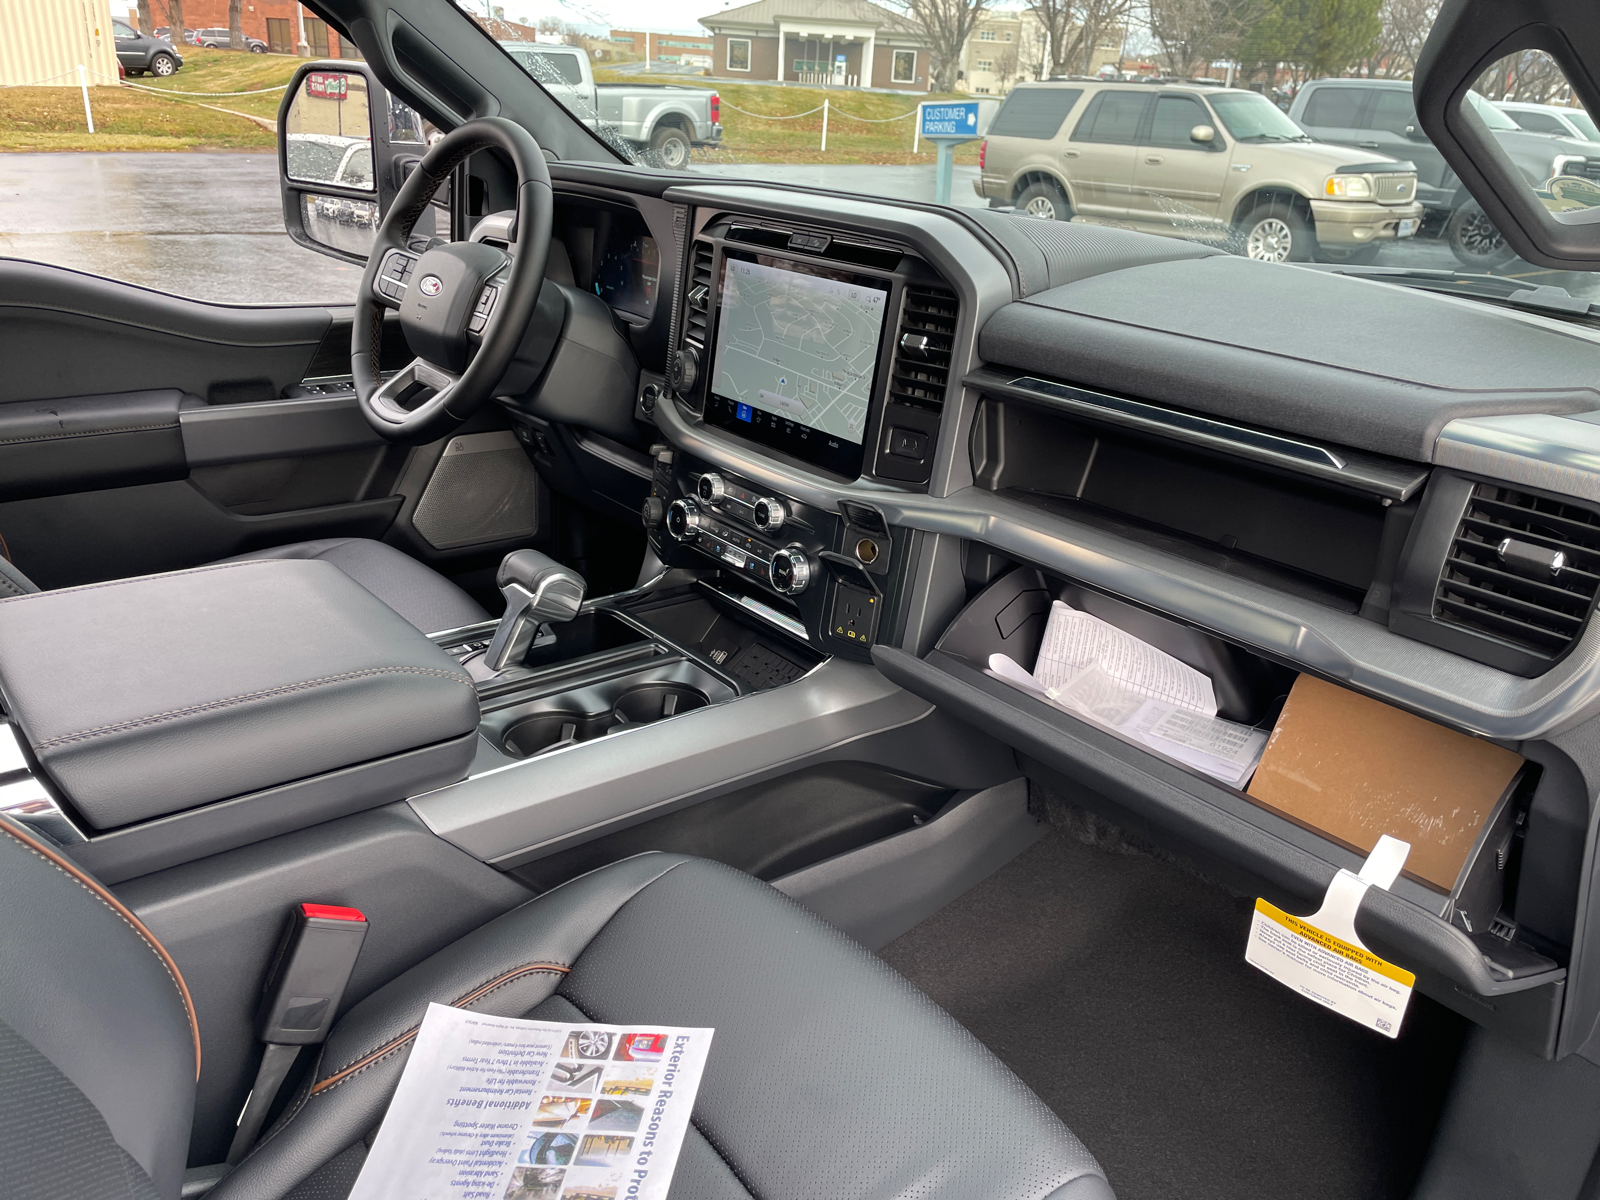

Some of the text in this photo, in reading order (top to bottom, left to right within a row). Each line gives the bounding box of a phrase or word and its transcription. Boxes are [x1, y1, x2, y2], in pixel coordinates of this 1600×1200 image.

[926, 108, 966, 120] CUSTOMER
[925, 121, 956, 133] PARKING
[828, 440, 839, 449] Audio
[1210, 742, 1238, 755] 61924
[1284, 916, 1297, 926] THIS
[1298, 923, 1323, 940] VEHICLE
[1332, 940, 1363, 958] EQUIPPED
[1365, 955, 1382, 967] WITH
[1299, 930, 1362, 964] ADVANCED AIR BAGS
[1290, 933, 1368, 974] EVEN WITH ADVANCED AIR BAGS
[662, 1035, 690, 1088] Exterior
[446, 1099, 531, 1110] Additional Benefits
[453, 1120, 479, 1129] Spotting
[642, 1089, 673, 1148] Reasons
[478, 1149, 508, 1157] Headlight
[637, 1150, 653, 1165] to
[428, 1157, 458, 1165] Overspray
[450, 1179, 495, 1188] De-icing Agents
